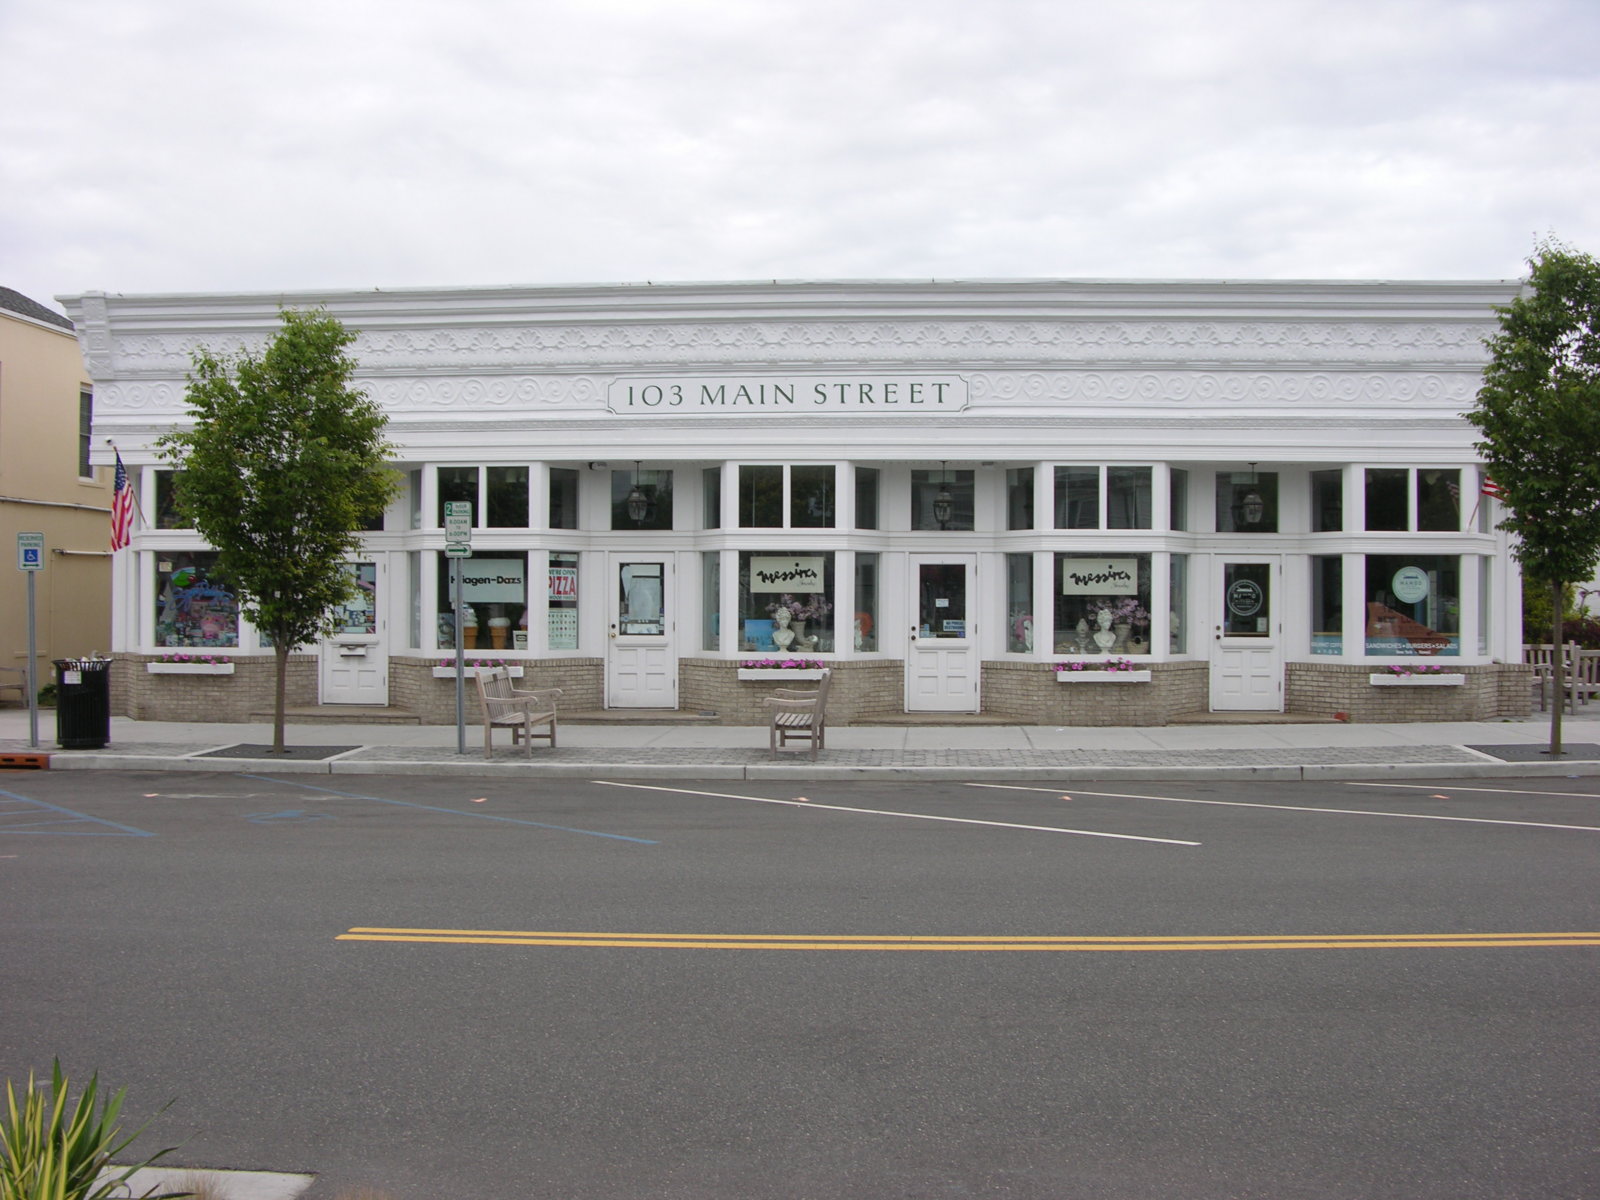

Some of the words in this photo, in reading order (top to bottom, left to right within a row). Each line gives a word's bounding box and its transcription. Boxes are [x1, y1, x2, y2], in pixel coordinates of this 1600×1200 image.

[628, 384, 684, 407] 103
[700, 383, 796, 406] MAIN
[813, 382, 951, 405] STREET
[1366, 642, 1402, 650] SANDWICHES
[1406, 642, 1433, 650] BURGERS
[1435, 642, 1458, 650] SALADS
